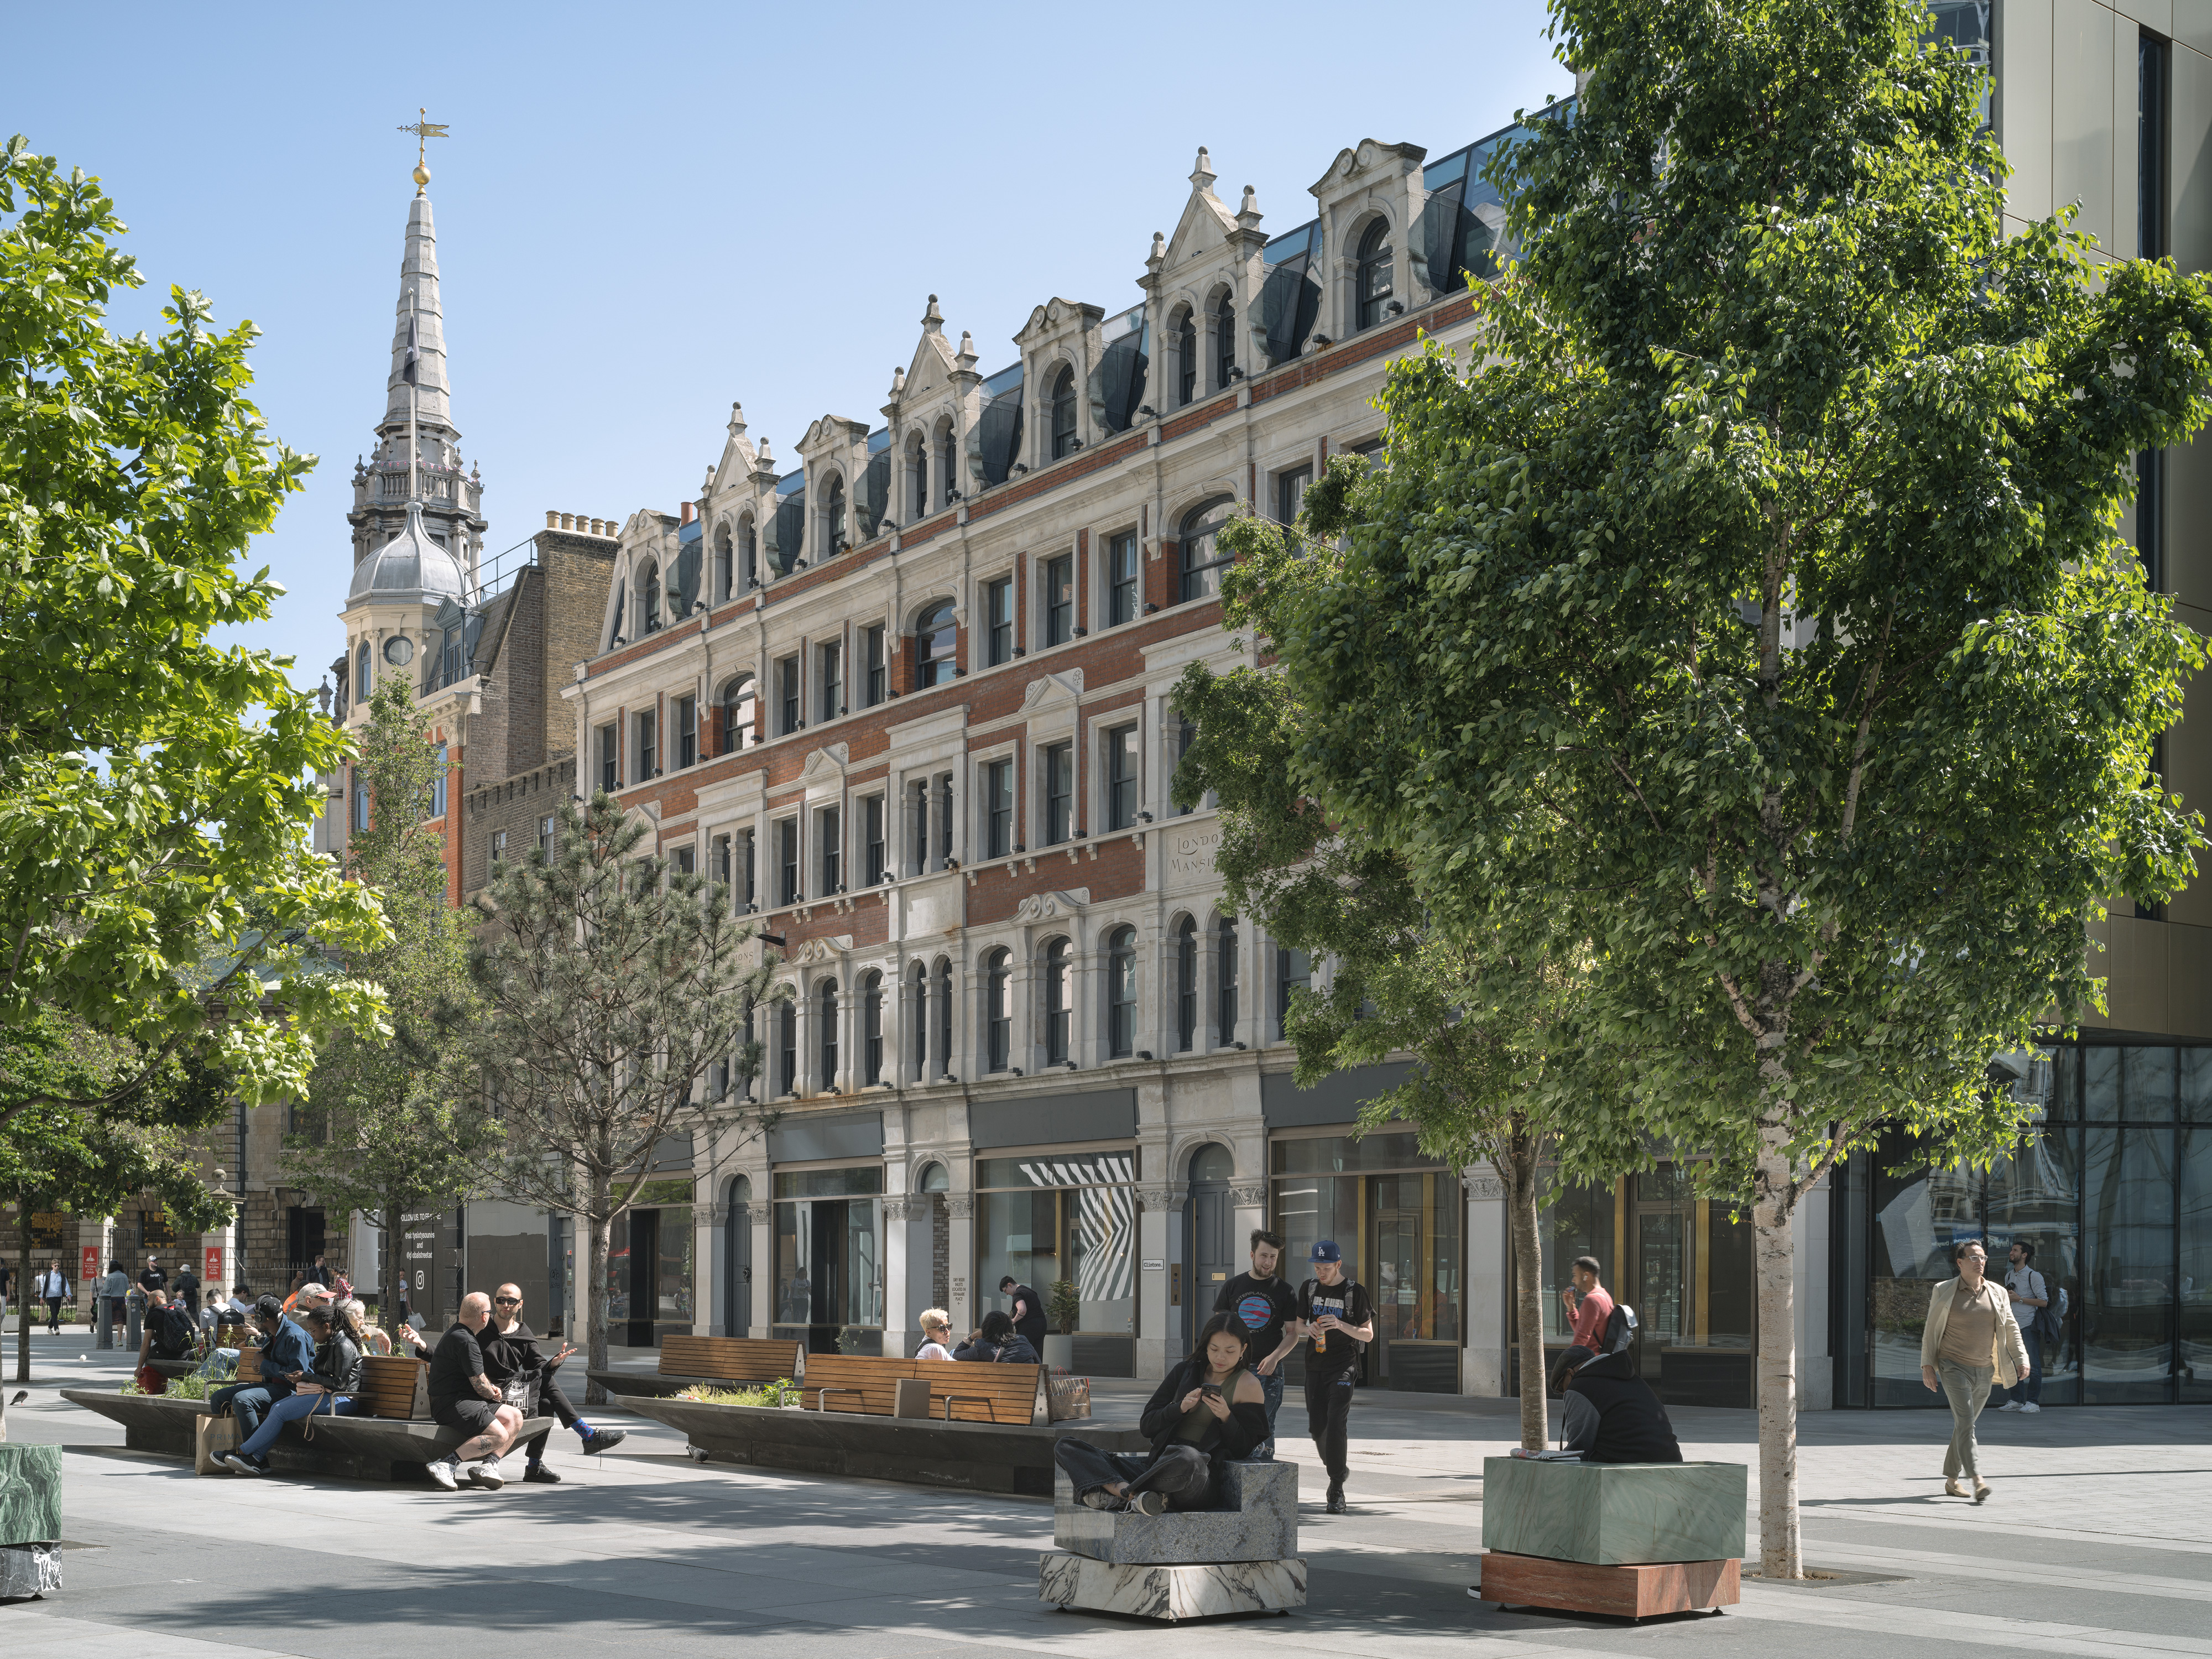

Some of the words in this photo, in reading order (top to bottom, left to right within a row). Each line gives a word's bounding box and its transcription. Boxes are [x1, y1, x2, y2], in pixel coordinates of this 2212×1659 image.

[1178, 832, 1226, 855] LONDON
[1170, 855, 1218, 874] MANSIO
[1318, 1246, 1325, 1256] LA
[1235, 1291, 1276, 1309] INTERPLANETARY
[1312, 1305, 1343, 1318] SEASON
